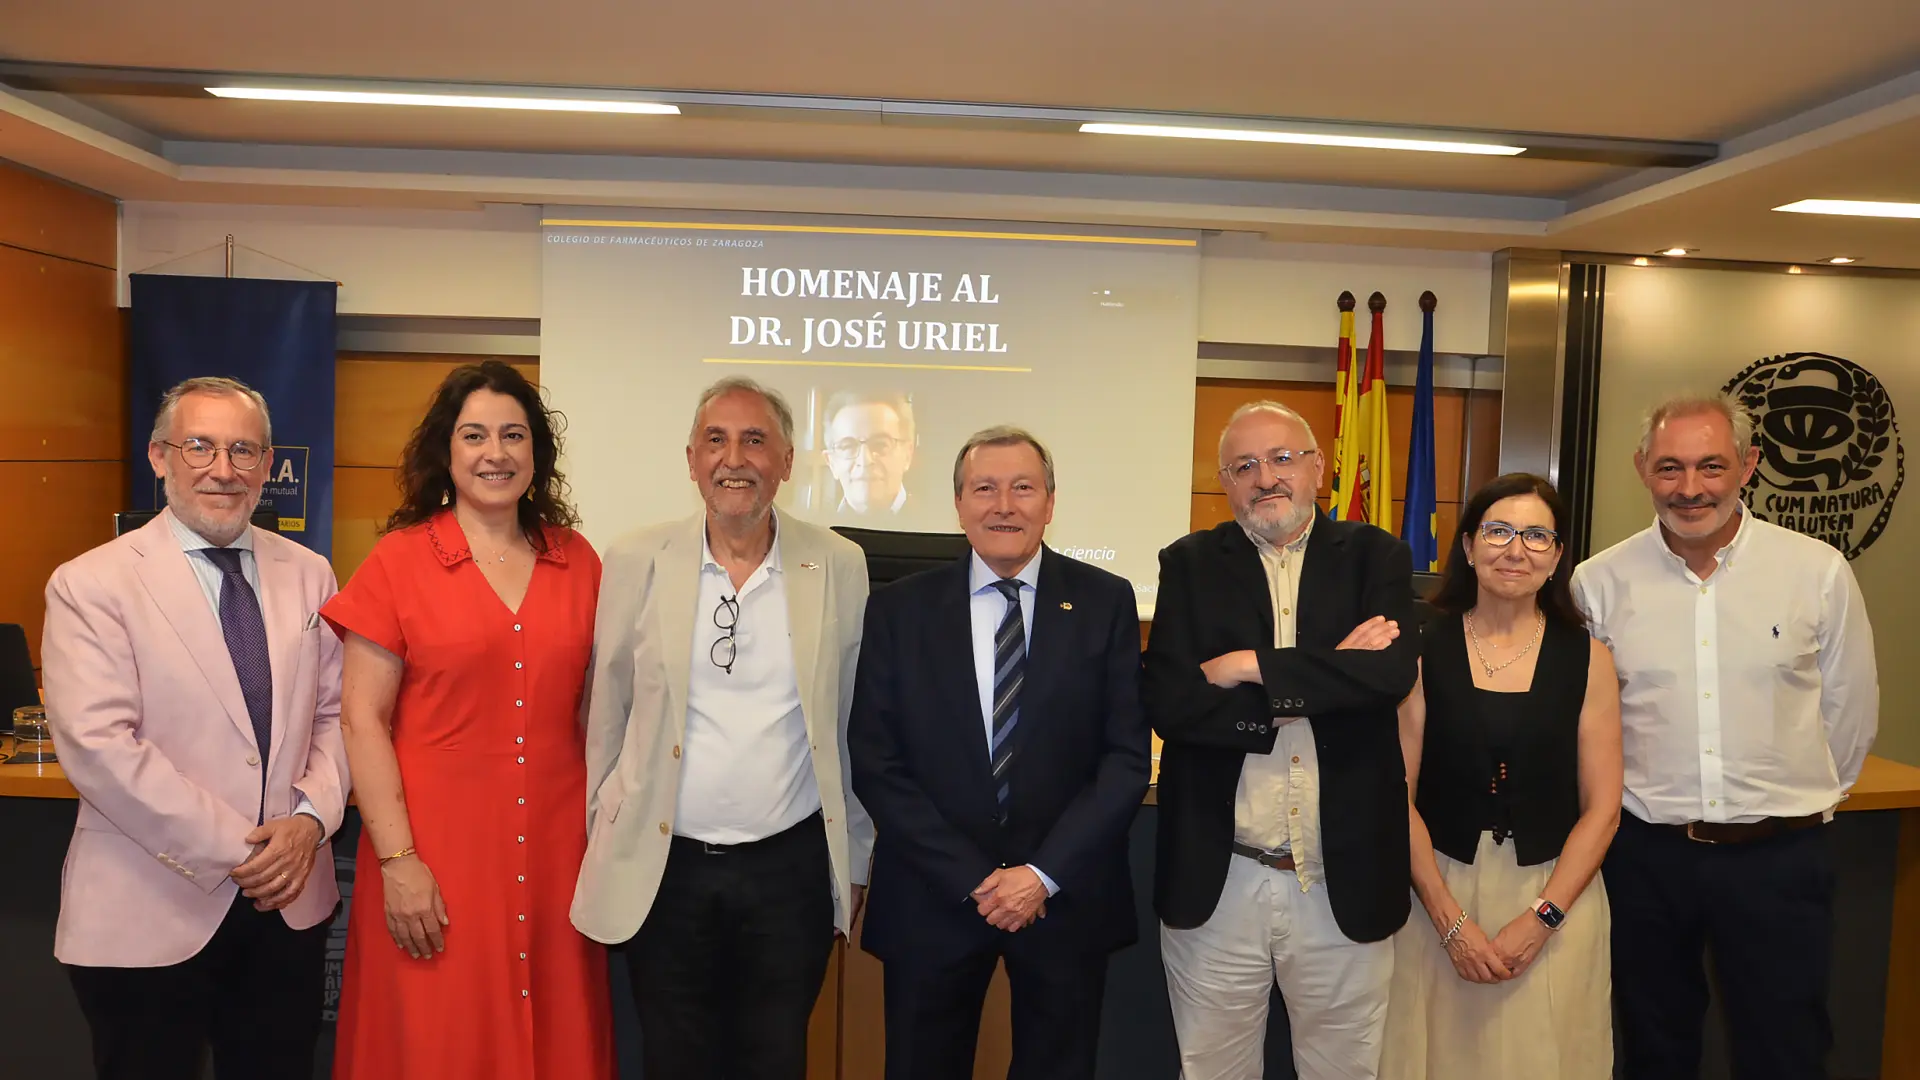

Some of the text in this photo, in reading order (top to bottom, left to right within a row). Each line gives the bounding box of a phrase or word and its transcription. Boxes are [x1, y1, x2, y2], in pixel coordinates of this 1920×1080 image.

[547, 235, 590, 244] COLEGIO
[594, 236, 605, 244] DE
[696, 238, 708, 246] DE
[712, 239, 764, 248] ZARAGOZA
[741, 267, 999, 307] HOMENAJE AL
[729, 311, 1007, 354] DR. JOSÉ URIEL
[1766, 493, 1804, 514] CUM
[1809, 482, 1885, 514] NATURA
[1777, 513, 1854, 534] SALUTEM
[1063, 546, 1116, 560] ciencia
